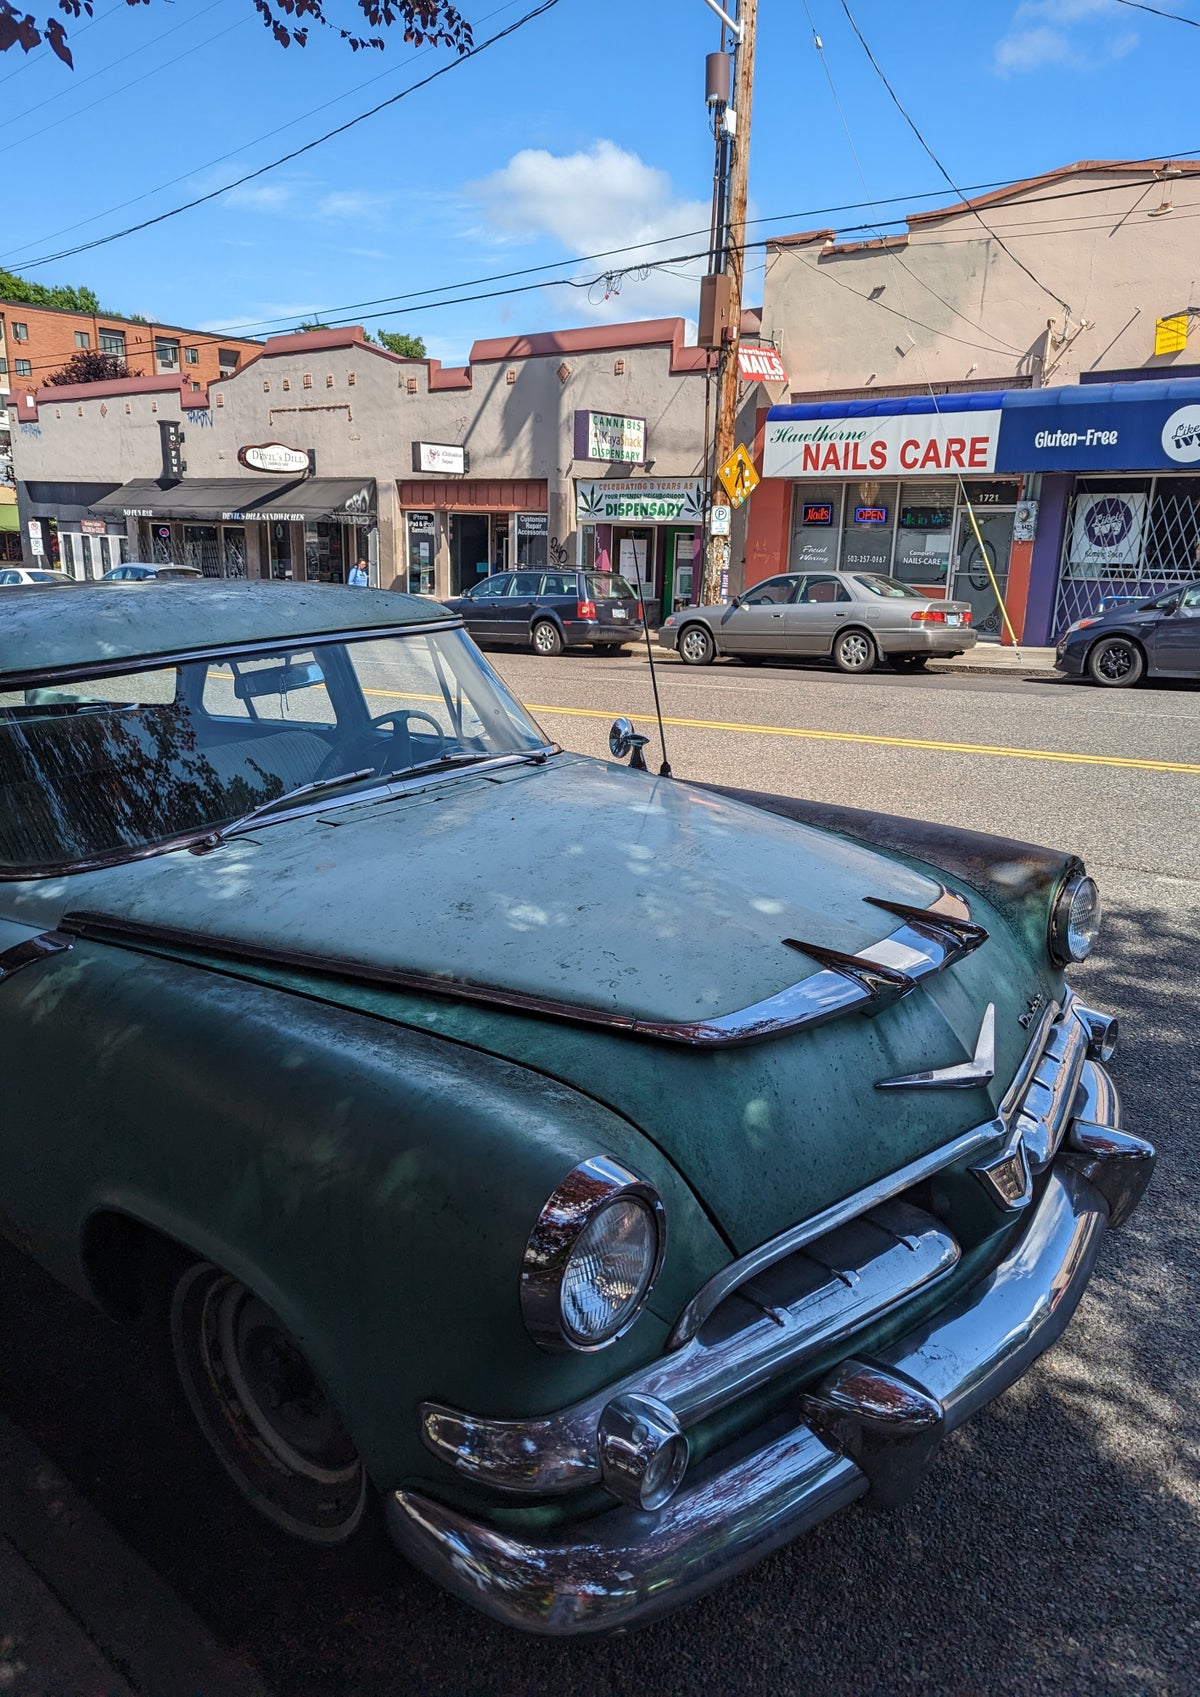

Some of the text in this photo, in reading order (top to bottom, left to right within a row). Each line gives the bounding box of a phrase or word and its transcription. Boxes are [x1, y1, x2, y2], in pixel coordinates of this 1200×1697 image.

[738, 354, 784, 375] NAILS
[593, 415, 641, 431] CANNABIS
[169, 427, 176, 441] NO
[770, 425, 866, 444] Hawthorne
[1171, 423, 1200, 439] Like
[1034, 429, 1118, 448] Gluten-Free
[592, 447, 641, 461] DISPENSARY
[802, 436, 989, 471] NAILS CARE
[657, 482, 681, 490] YEARS
[684, 482, 693, 490] AS
[979, 494, 999, 502] 1721
[605, 502, 685, 517] DISPENSARY
[804, 507, 829, 521] Nails
[857, 510, 885, 521] OPEN
[520, 515, 547, 523] Customize
[525, 522, 542, 530] Repair
[803, 545, 828, 553] Facial
[903, 557, 941, 565] NAILS-CARE
